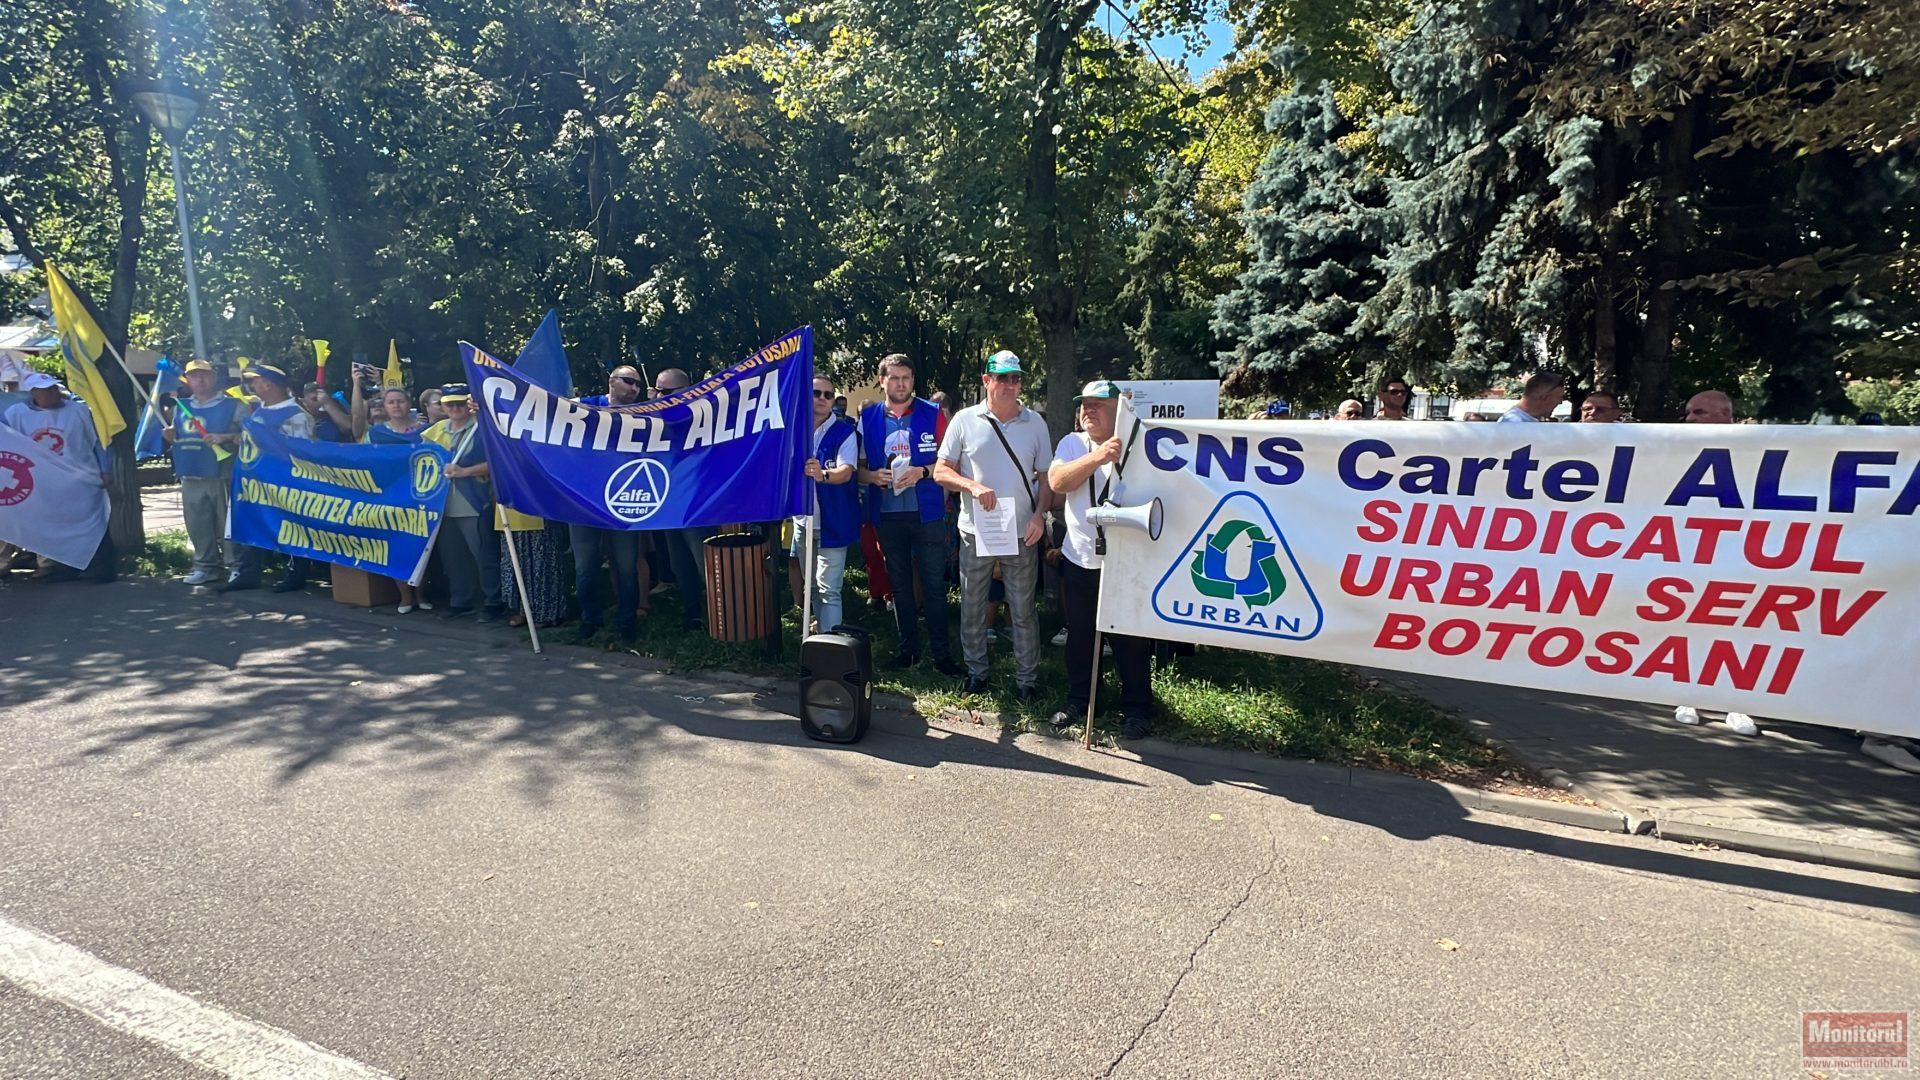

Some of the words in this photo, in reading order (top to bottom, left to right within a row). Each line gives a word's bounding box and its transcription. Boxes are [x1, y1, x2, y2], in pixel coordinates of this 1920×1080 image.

[483, 376, 673, 453] CARTEL
[683, 369, 785, 451] ALFA
[1151, 404, 1185, 419] PARC
[289, 454, 383, 494] SINDICATUL
[1144, 427, 1305, 485] CNS
[1337, 439, 1636, 503] Cartel
[619, 489, 652, 502] alfa
[278, 520, 310, 548] DIN
[1356, 500, 1865, 575] SINDICATUL
[1173, 600, 1301, 633] URBAN
[1340, 554, 1614, 617] URBAN
[1636, 577, 1888, 636] SERV
[1373, 613, 1805, 695] BOTOSANI
